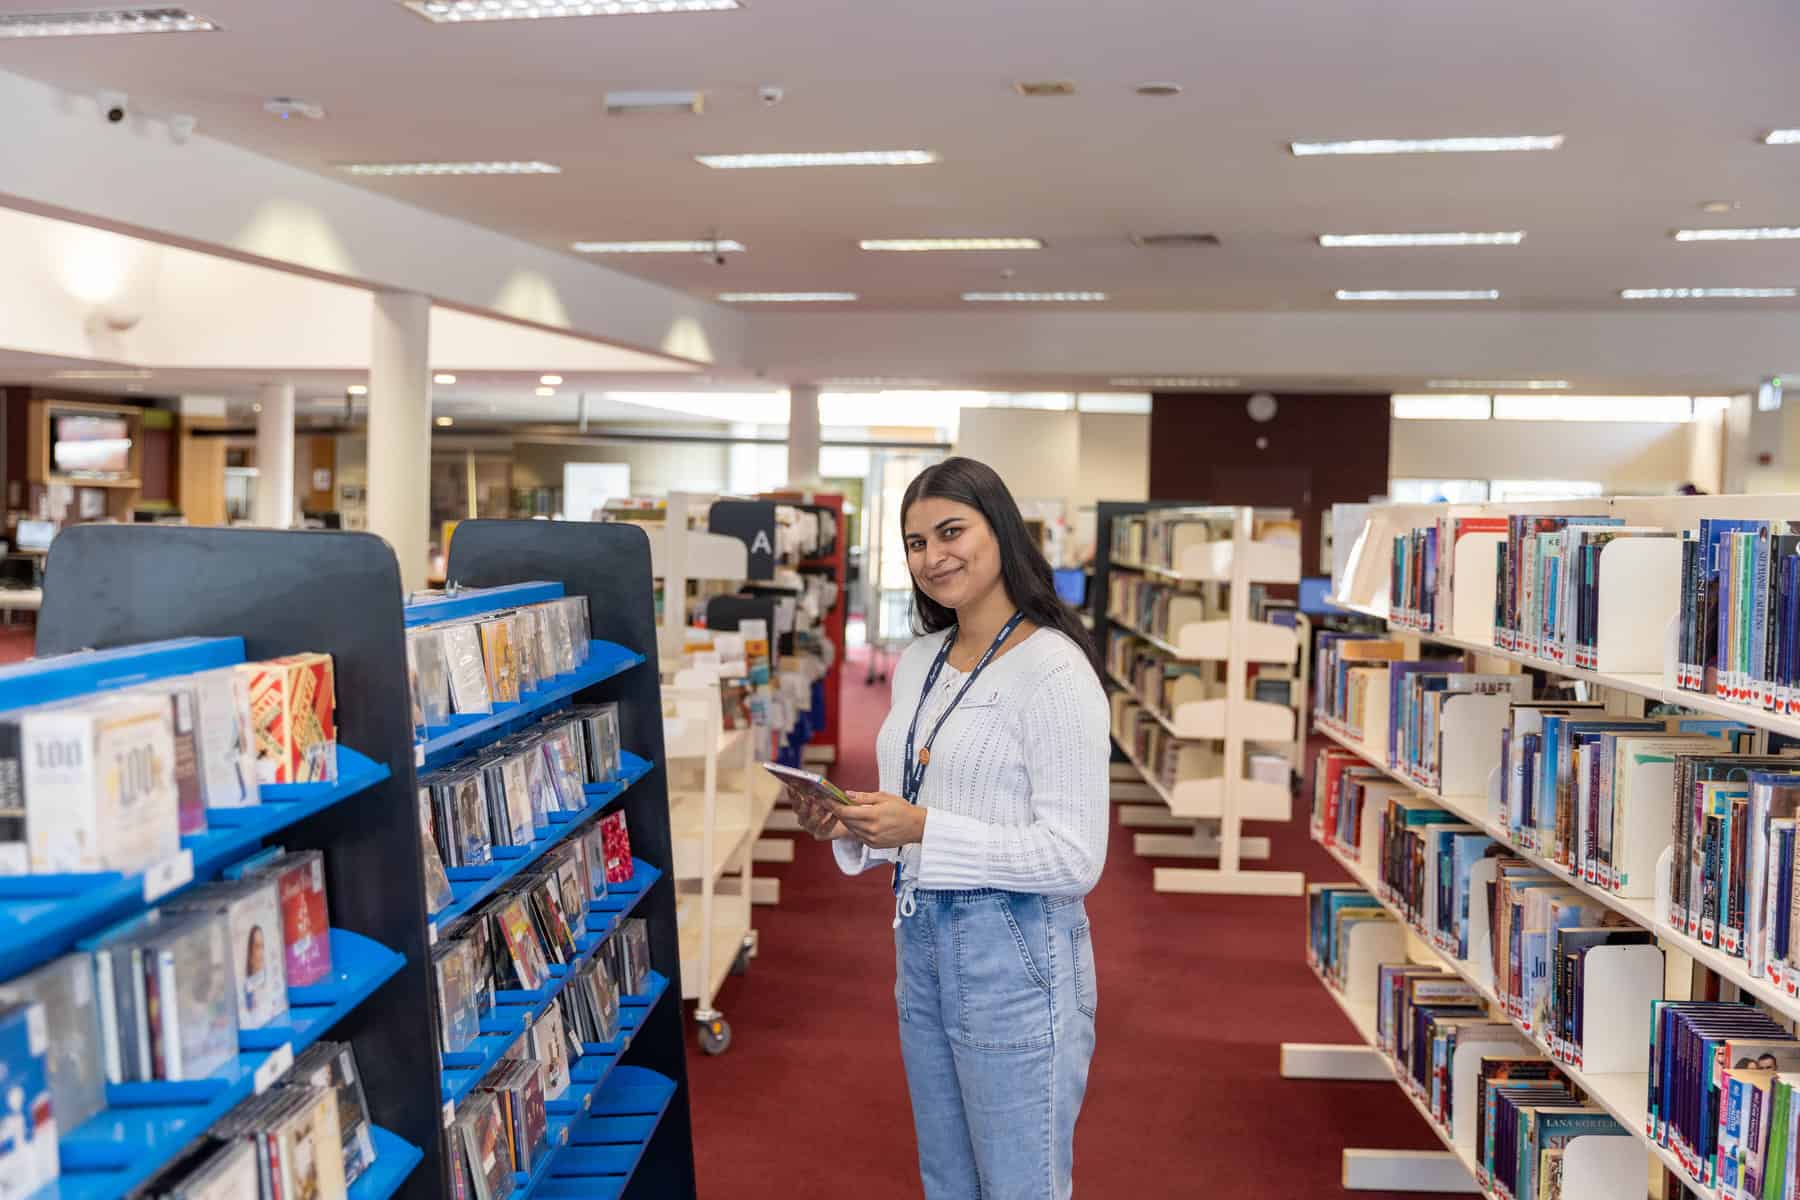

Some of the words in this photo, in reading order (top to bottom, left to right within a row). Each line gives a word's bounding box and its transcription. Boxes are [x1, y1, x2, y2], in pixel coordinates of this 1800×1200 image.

[751, 530, 772, 555] A
[1697, 557, 1707, 602] LANE
[33, 740, 83, 768] 100
